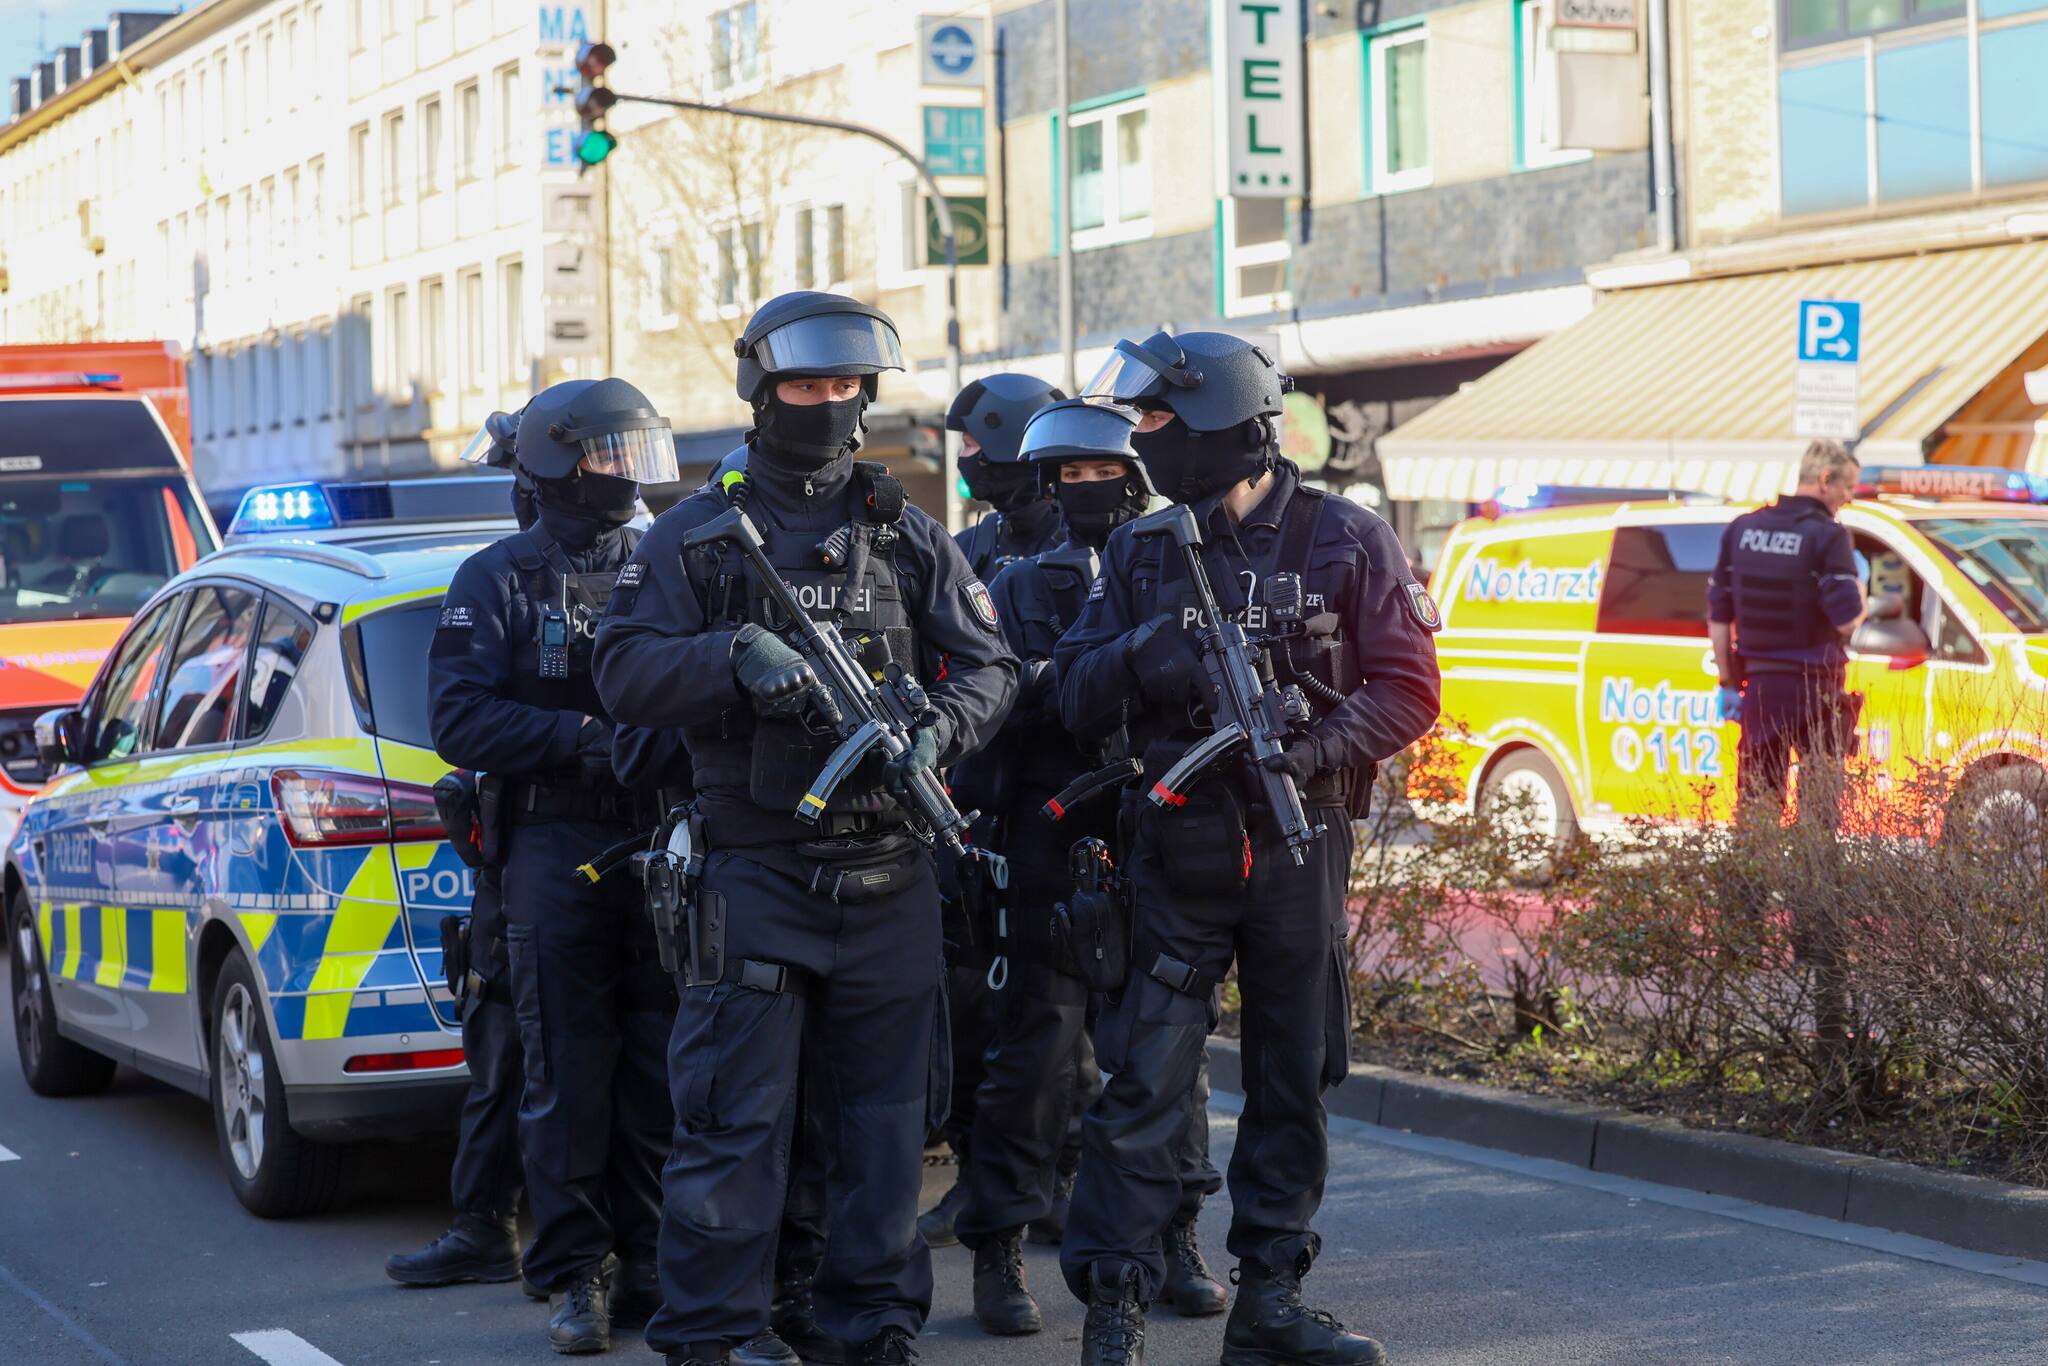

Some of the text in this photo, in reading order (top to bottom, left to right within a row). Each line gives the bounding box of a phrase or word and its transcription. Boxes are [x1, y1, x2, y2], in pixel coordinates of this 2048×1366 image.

[1804, 304, 1844, 357] P
[1901, 470, 1994, 495] NOTARZT
[1739, 528, 1802, 556] POLIZEI
[1466, 558, 1601, 601] Notarzt
[52, 832, 93, 873] POLIZEI
